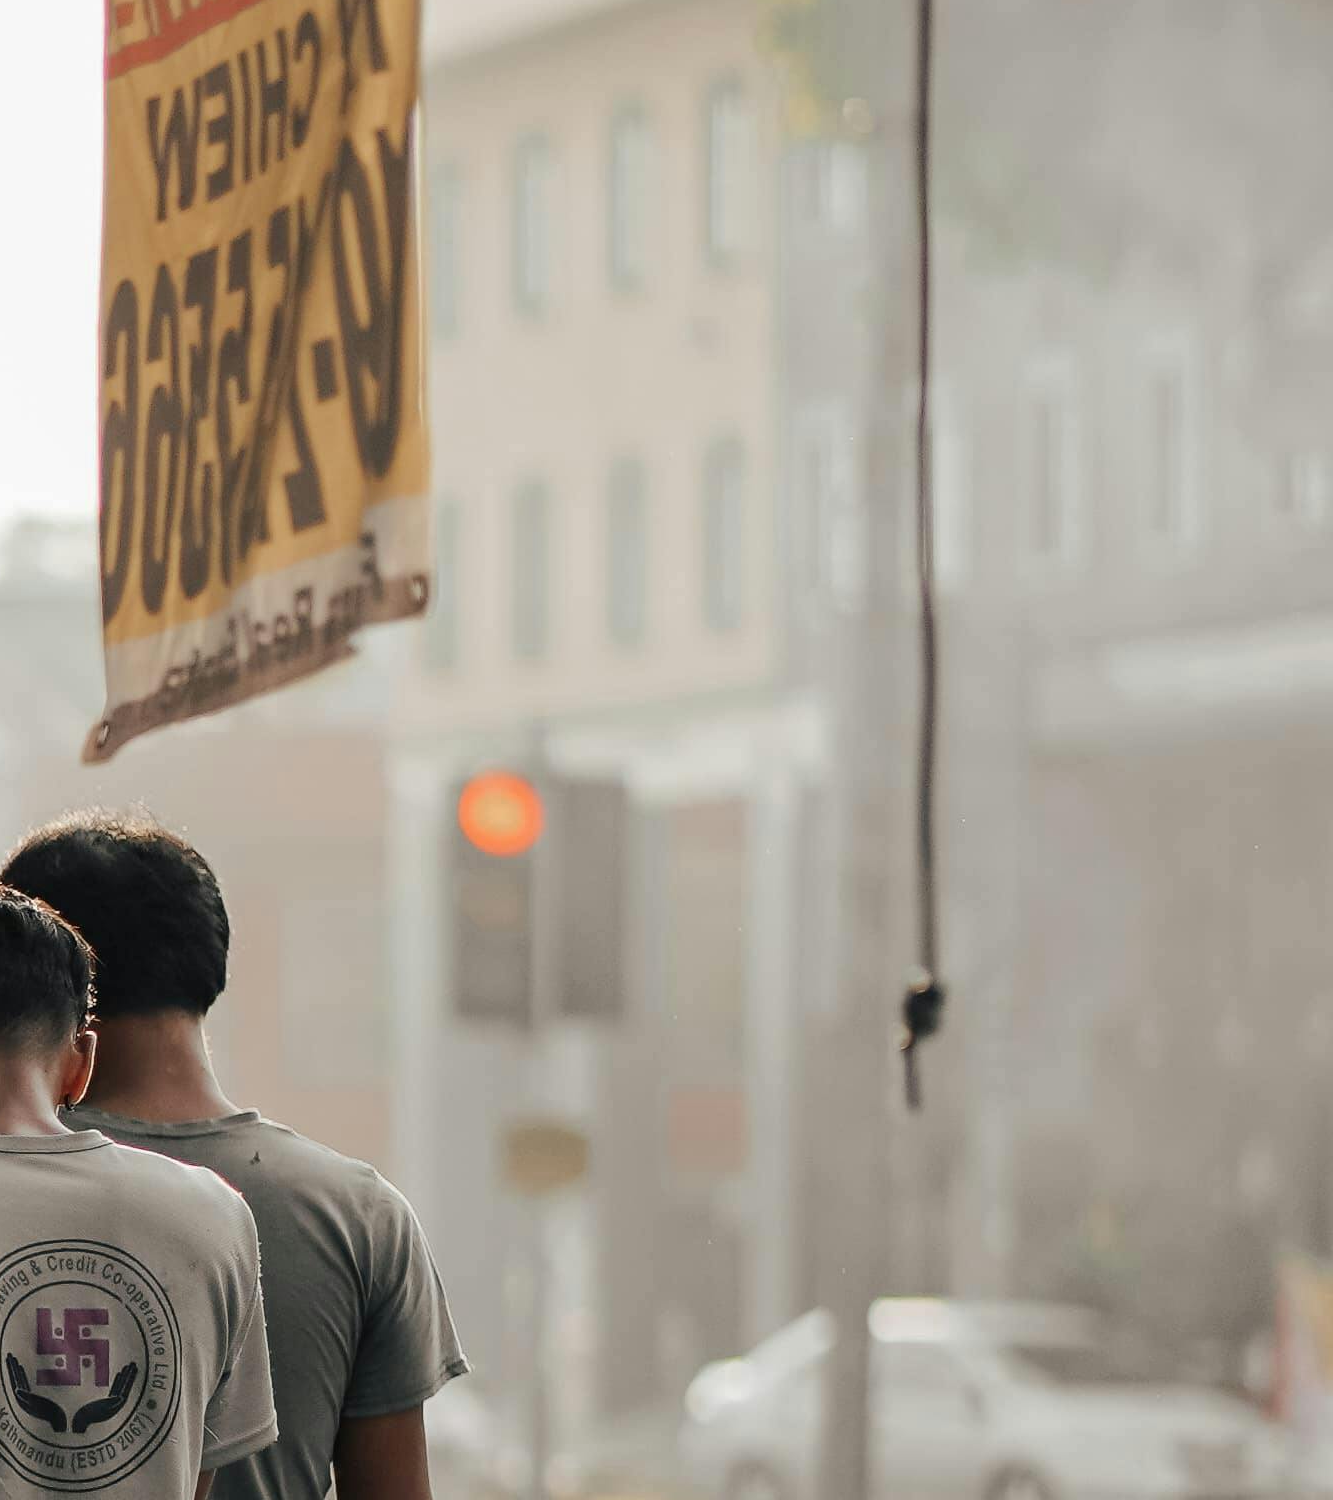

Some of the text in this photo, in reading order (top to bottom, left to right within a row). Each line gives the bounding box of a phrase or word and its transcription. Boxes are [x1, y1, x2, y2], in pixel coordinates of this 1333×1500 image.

[30, 1259, 42, 1277] &
[47, 1255, 97, 1274] Credit
[101, 1262, 166, 1356] Co-operative
[71, 1441, 117, 1473] (ESTD
